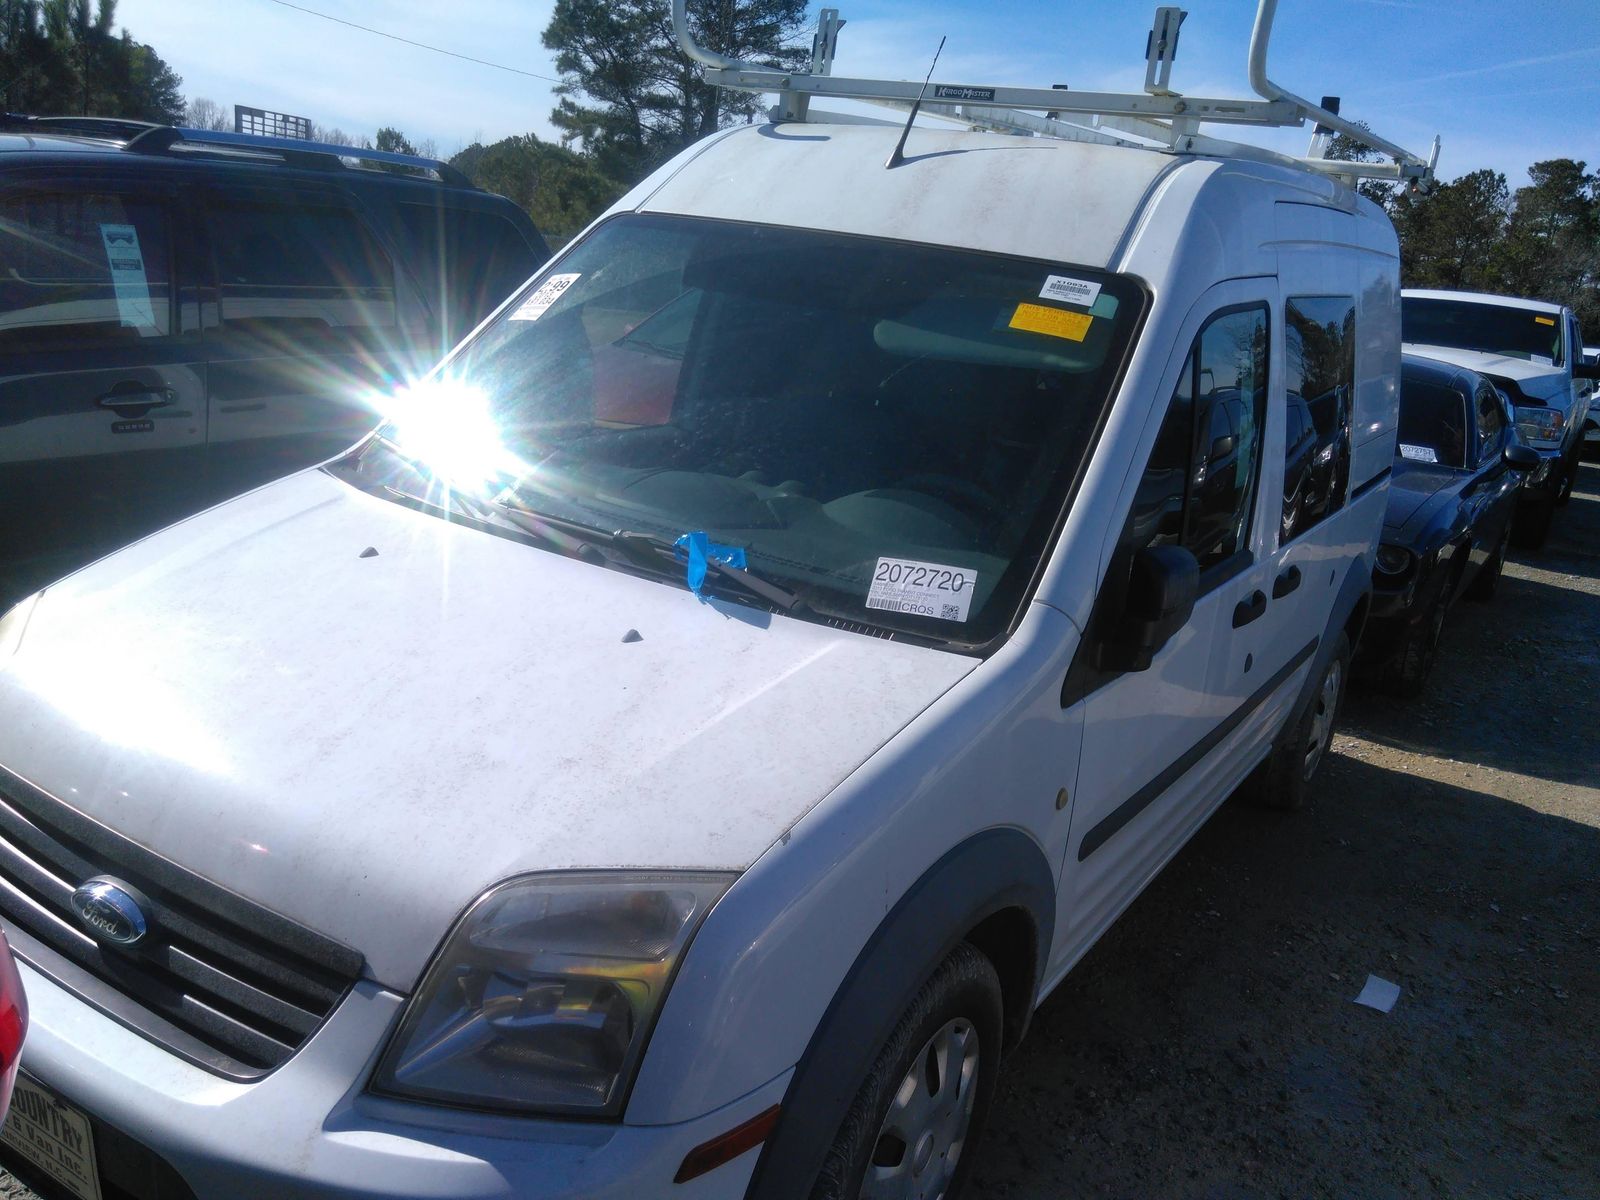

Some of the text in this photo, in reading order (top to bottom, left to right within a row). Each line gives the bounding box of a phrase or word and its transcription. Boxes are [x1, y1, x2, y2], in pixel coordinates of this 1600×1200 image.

[875, 562, 964, 592] 2072720
[901, 602, 934, 615] CROS
[82, 901, 117, 935] Ford
[26, 1123, 54, 1155] Van
